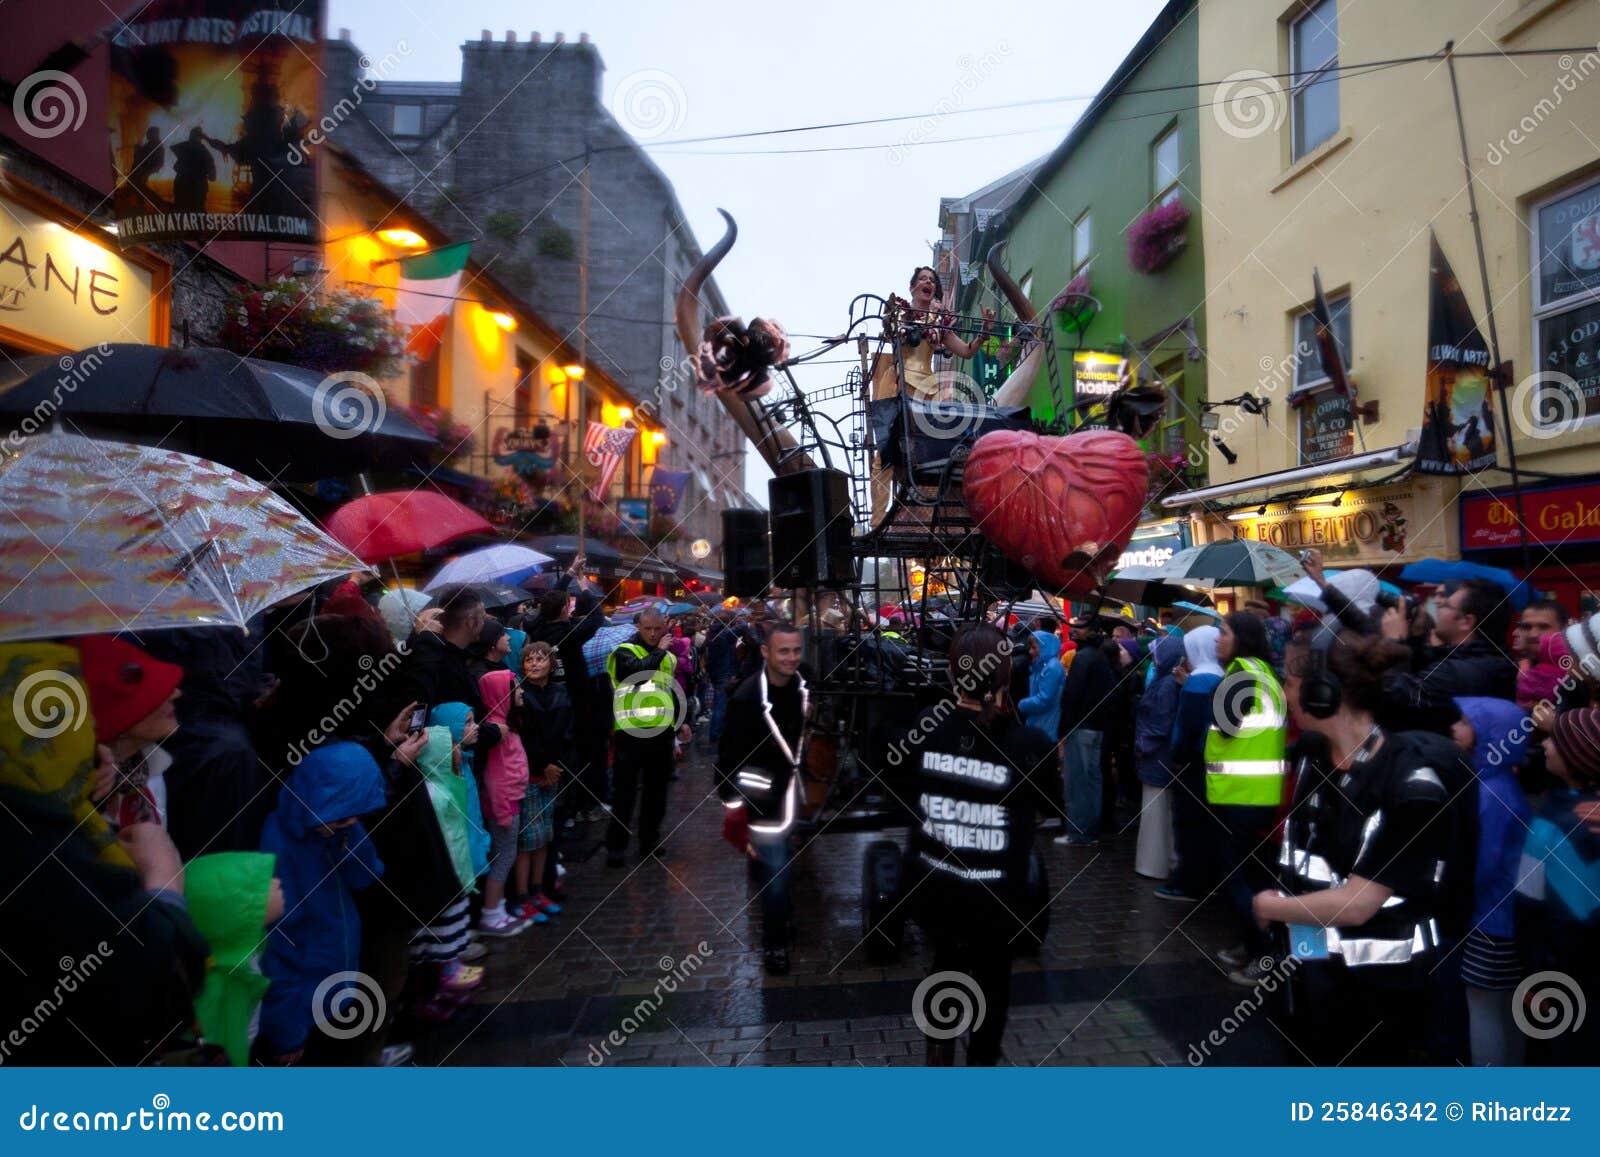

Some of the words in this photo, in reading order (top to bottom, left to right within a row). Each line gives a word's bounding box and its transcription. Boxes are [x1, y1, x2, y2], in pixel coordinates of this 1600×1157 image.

[187, 16, 235, 45] ARTS
[1463, 349, 1488, 367] ARTS
[1488, 502, 1526, 526] Th
[923, 752, 1008, 784] macnas
[933, 823, 1005, 851] FRIEND
